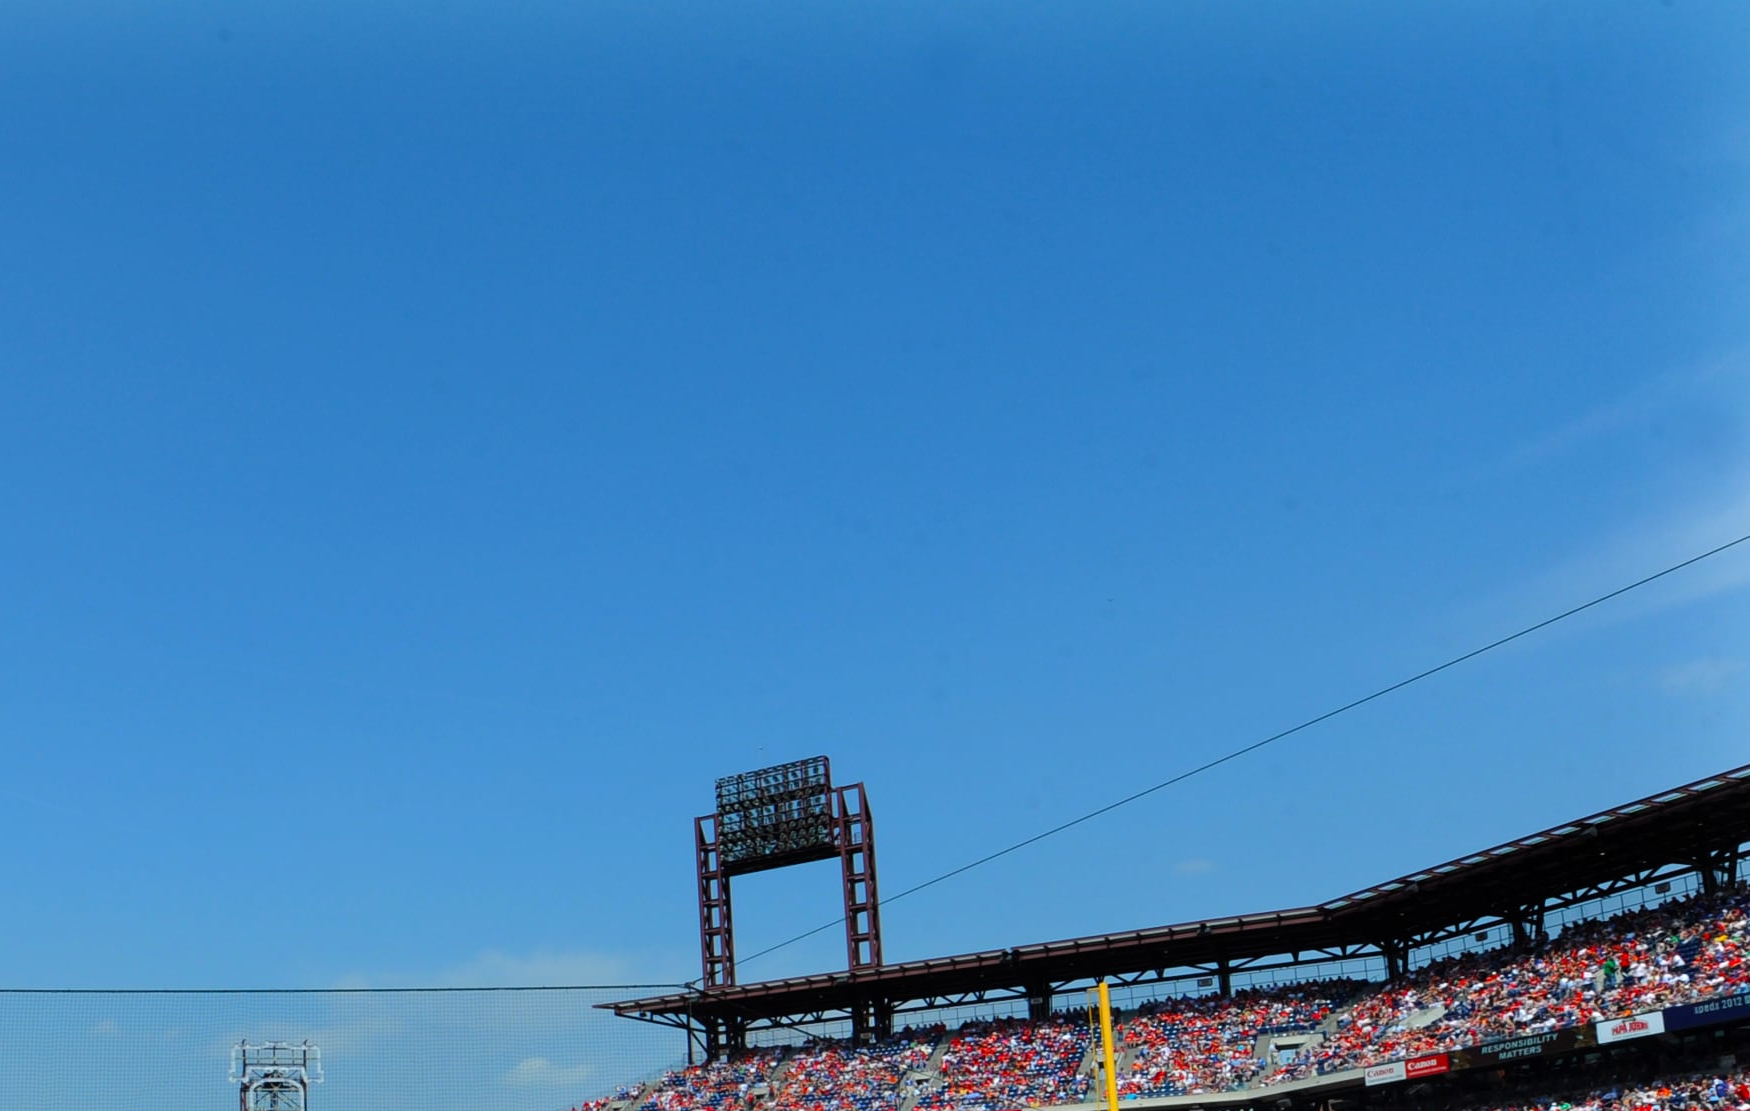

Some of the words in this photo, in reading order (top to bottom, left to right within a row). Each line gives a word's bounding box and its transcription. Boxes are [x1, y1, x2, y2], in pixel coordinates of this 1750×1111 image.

[1721, 997, 1743, 1010] 2012
[1481, 1032, 1558, 1055] RESPONSIBILITY
[1498, 1044, 1542, 1059] MATTERS
[1407, 1058, 1437, 1071] Canon
